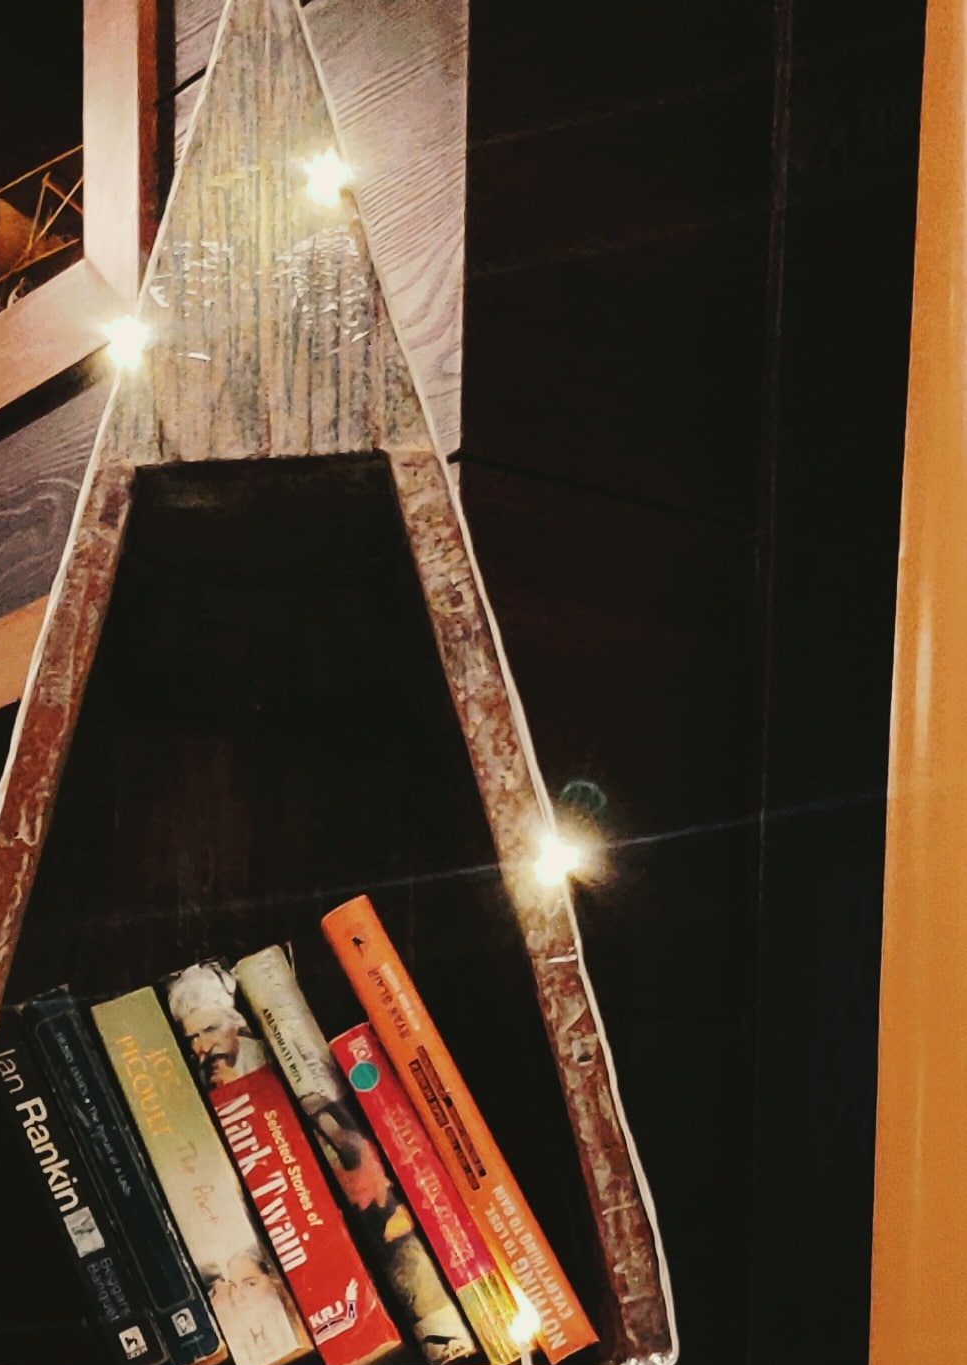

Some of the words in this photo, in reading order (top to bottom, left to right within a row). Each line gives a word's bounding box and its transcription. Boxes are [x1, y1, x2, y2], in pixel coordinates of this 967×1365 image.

[15, 1097, 79, 1212] Rankin
[215, 1093, 273, 1177] Mark
[251, 1170, 310, 1273] Twain
[263, 1109, 295, 1166] Selected
[287, 1163, 316, 1213] Stories
[304, 1210, 324, 1229] of
[492, 1184, 516, 1217] GAIN
[509, 1217, 526, 1236] TO
[100, 1257, 131, 1316] Beggars
[503, 1238, 518, 1259] TO
[518, 1233, 574, 1320] EVERYTHING
[511, 1257, 567, 1350] NOTHING
